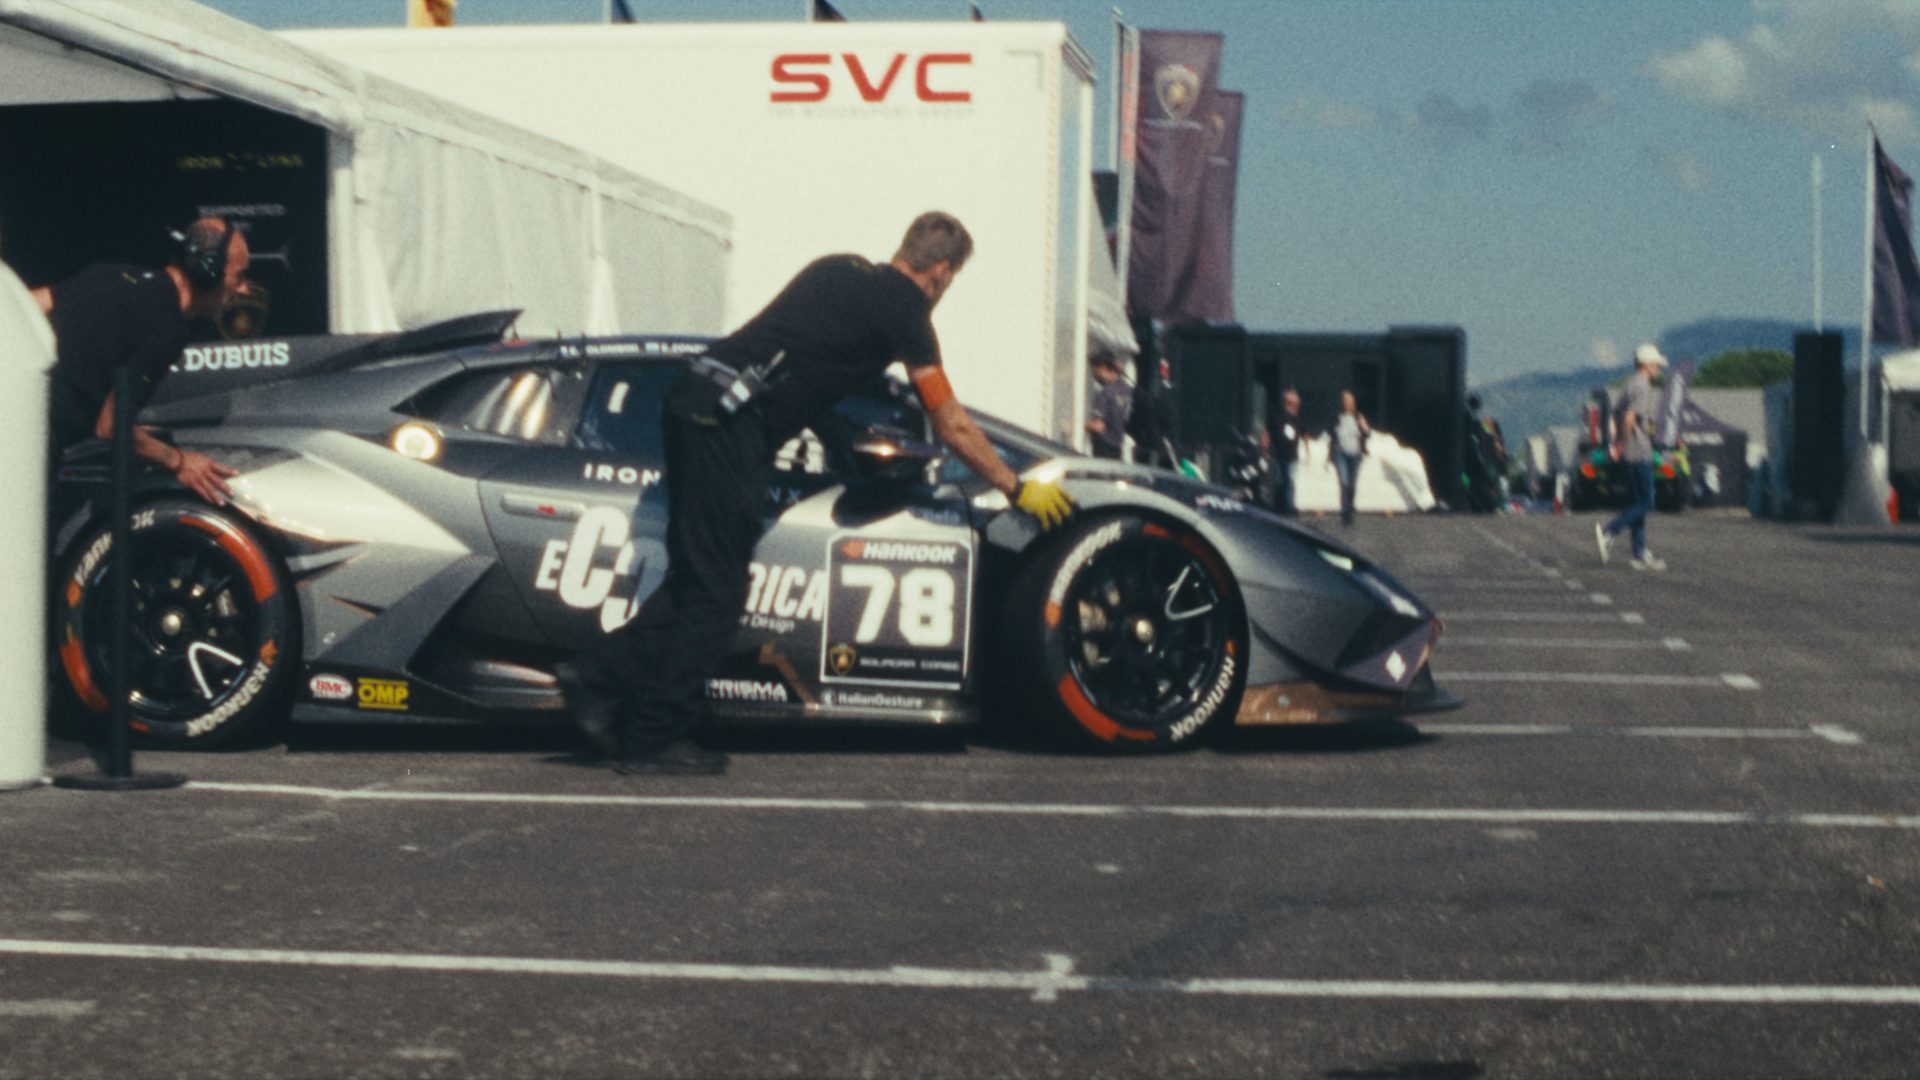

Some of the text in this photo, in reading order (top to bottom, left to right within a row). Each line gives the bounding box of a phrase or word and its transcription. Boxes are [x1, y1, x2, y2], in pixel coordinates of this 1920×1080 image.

[770, 53, 972, 103] SVC
[184, 341, 290, 371] DUBUIS
[584, 463, 662, 486] IRON
[745, 561, 827, 622] RICA
[841, 563, 955, 648] 78
[358, 681, 409, 705] OMP
